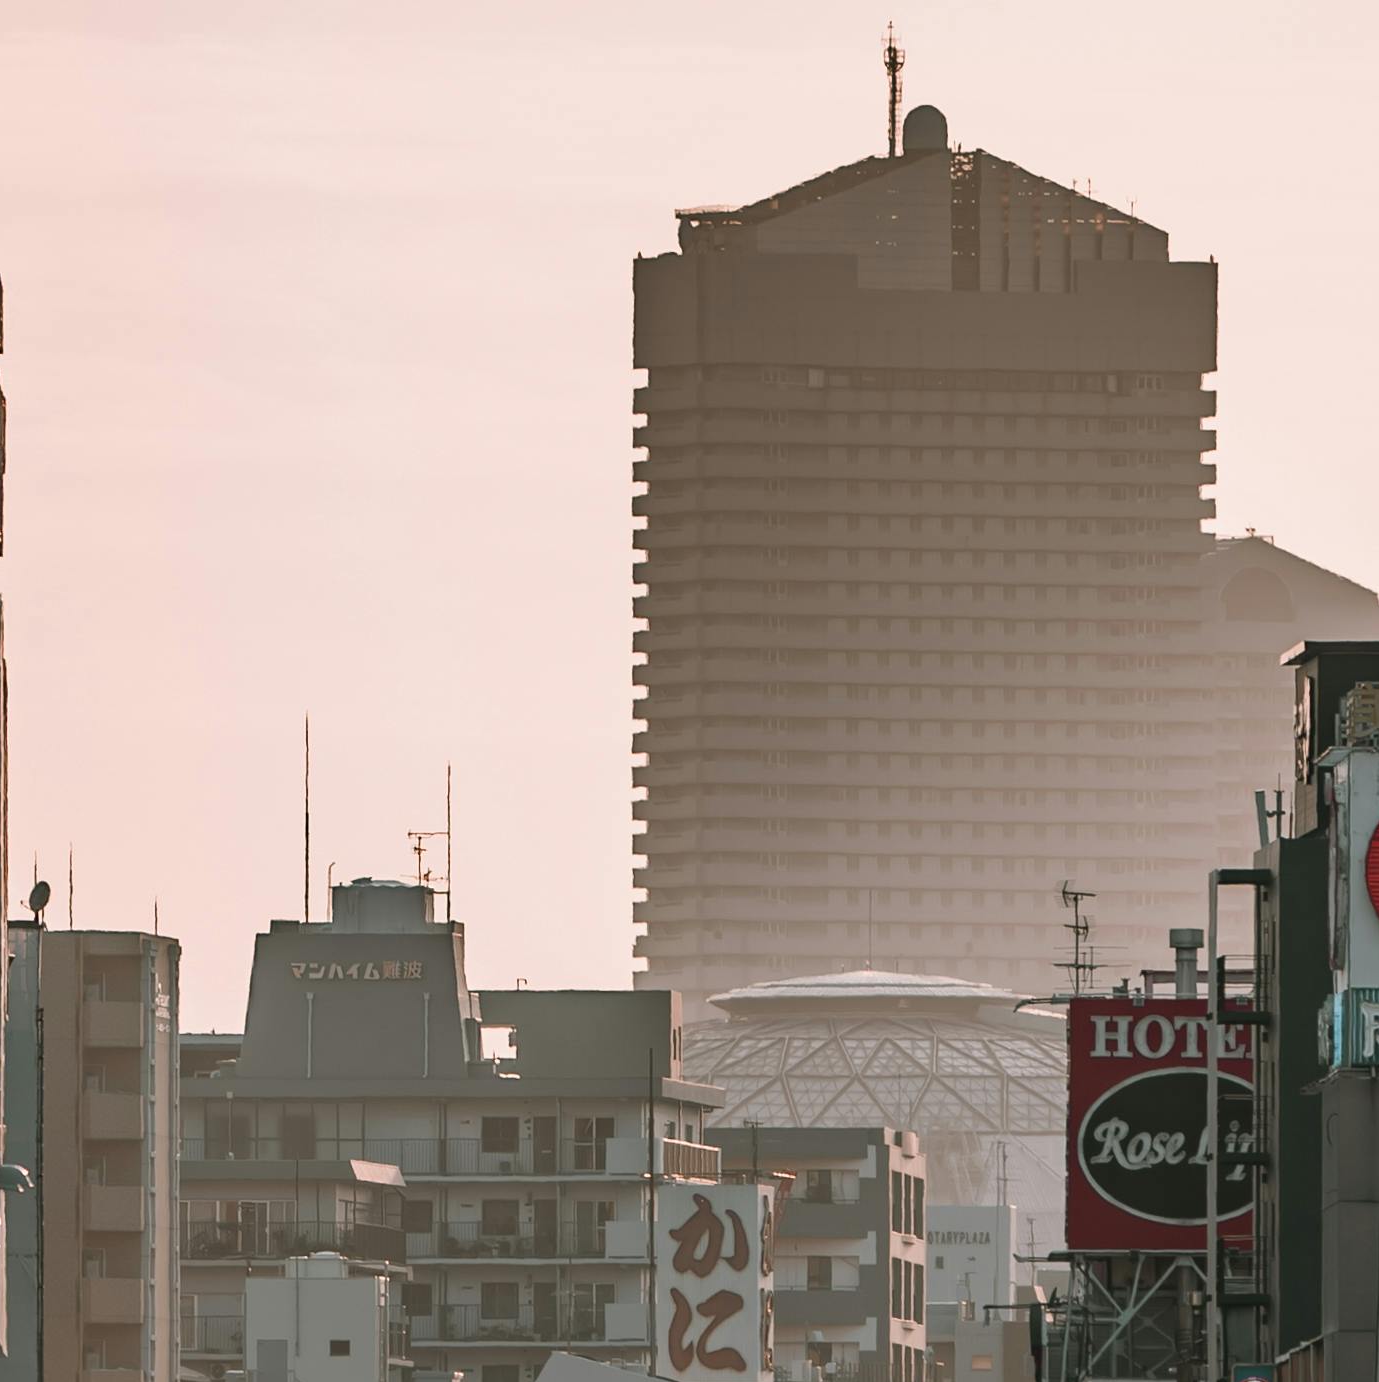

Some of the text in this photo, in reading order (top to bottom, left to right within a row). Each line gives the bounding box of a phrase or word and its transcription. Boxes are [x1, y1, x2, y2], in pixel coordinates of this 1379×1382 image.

[291, 961, 423, 981] マンハイム難波
[1090, 1014, 1254, 1060] HOTE
[1090, 1116, 1187, 1171] Rose
[669, 1193, 749, 1372] かに
